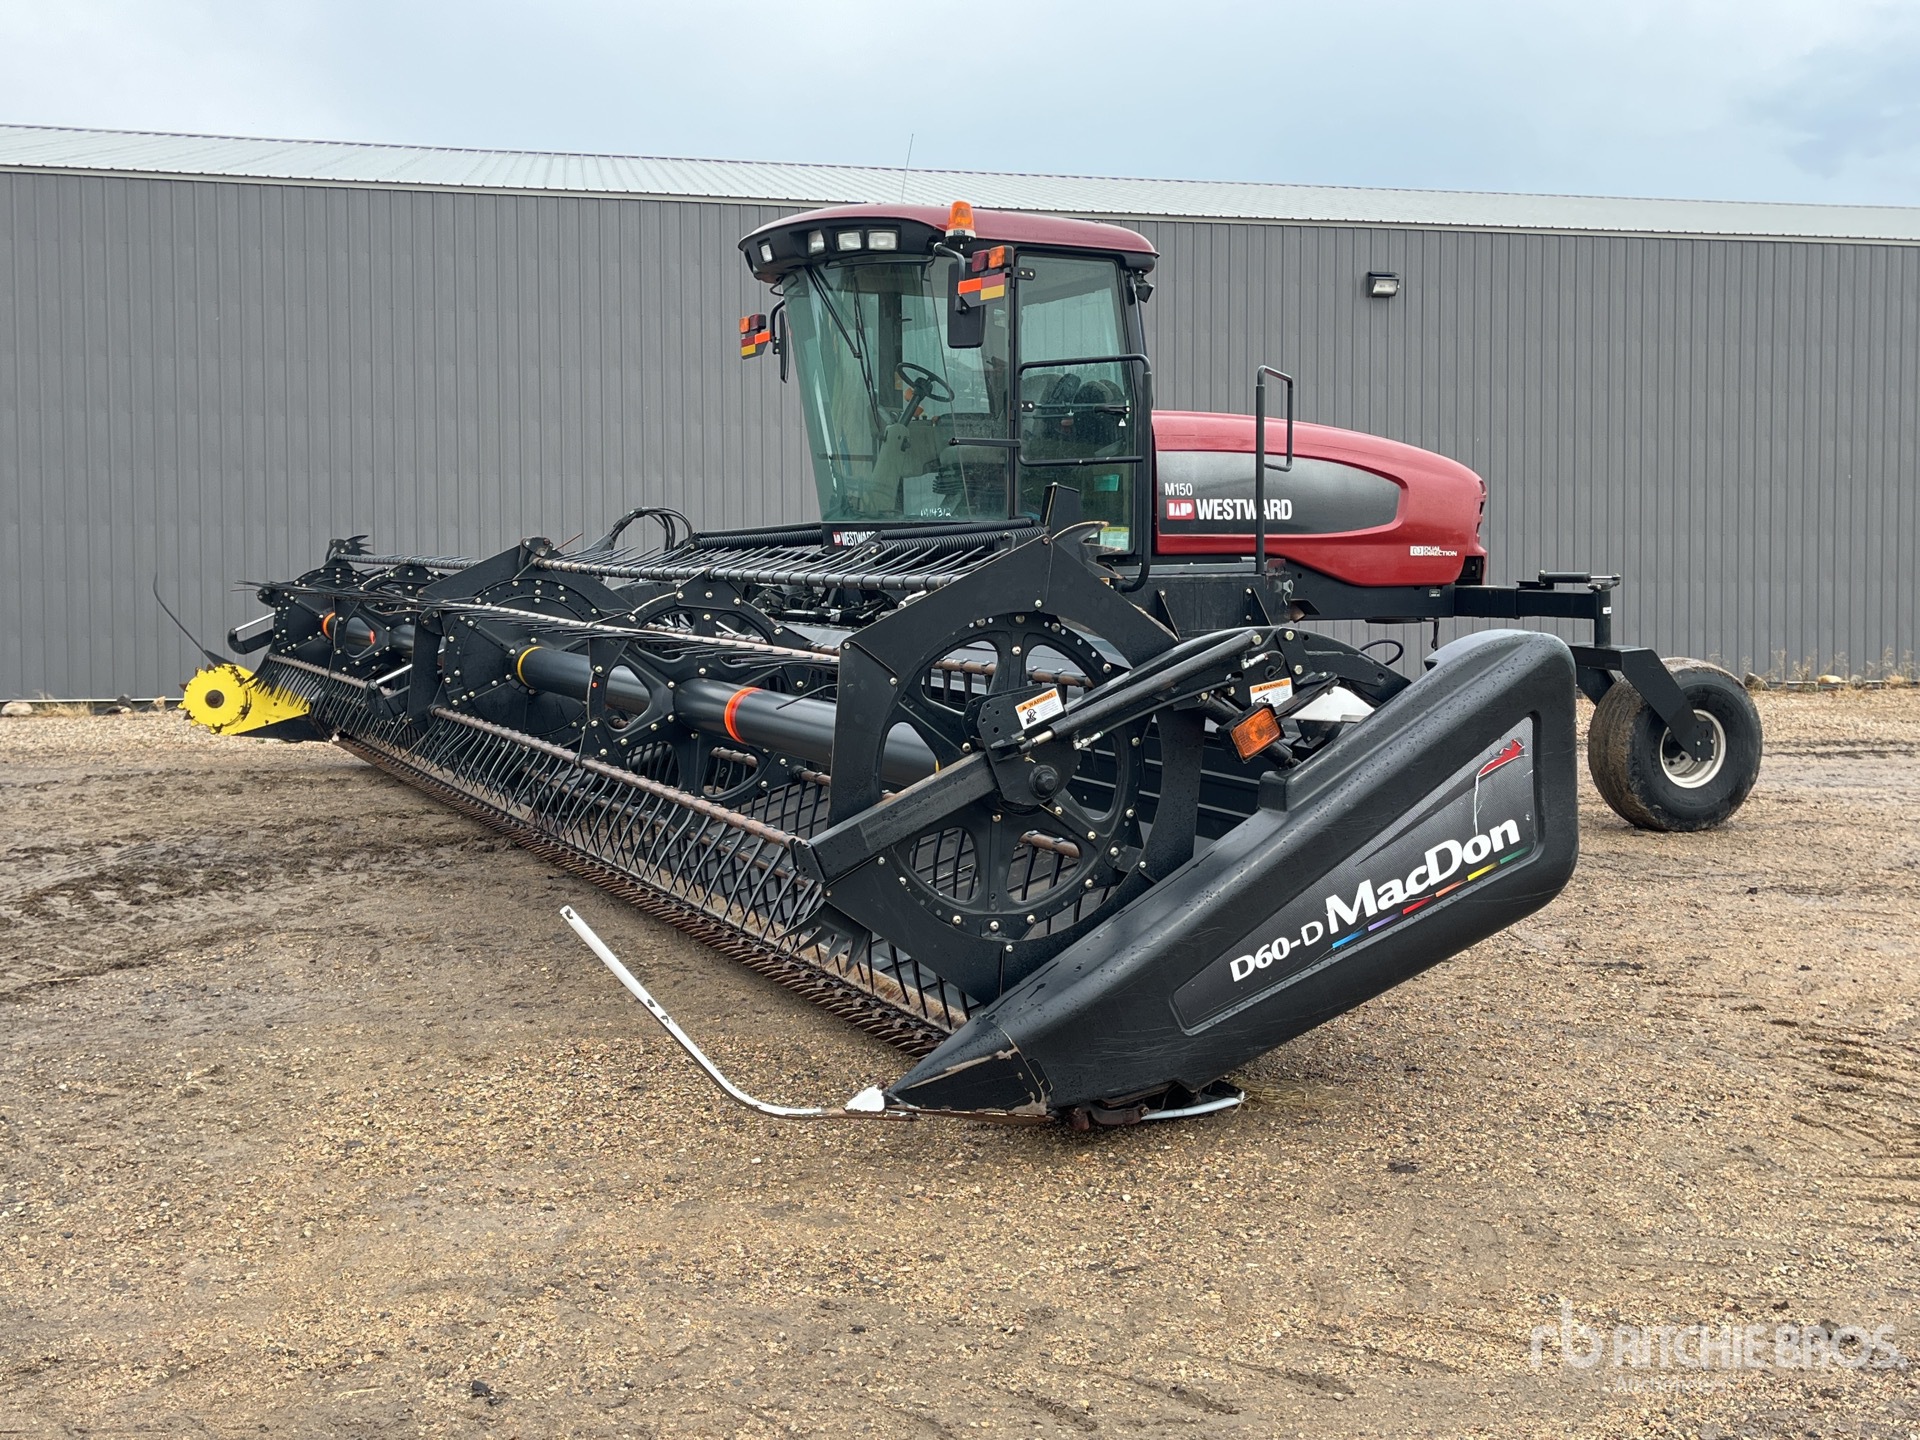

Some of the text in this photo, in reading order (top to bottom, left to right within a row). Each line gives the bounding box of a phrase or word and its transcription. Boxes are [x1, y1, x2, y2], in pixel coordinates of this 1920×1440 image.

[1164, 482, 1193, 496] M150
[1196, 499, 1292, 520] WESTWARD
[1229, 819, 1521, 982] D60-D MacDon
